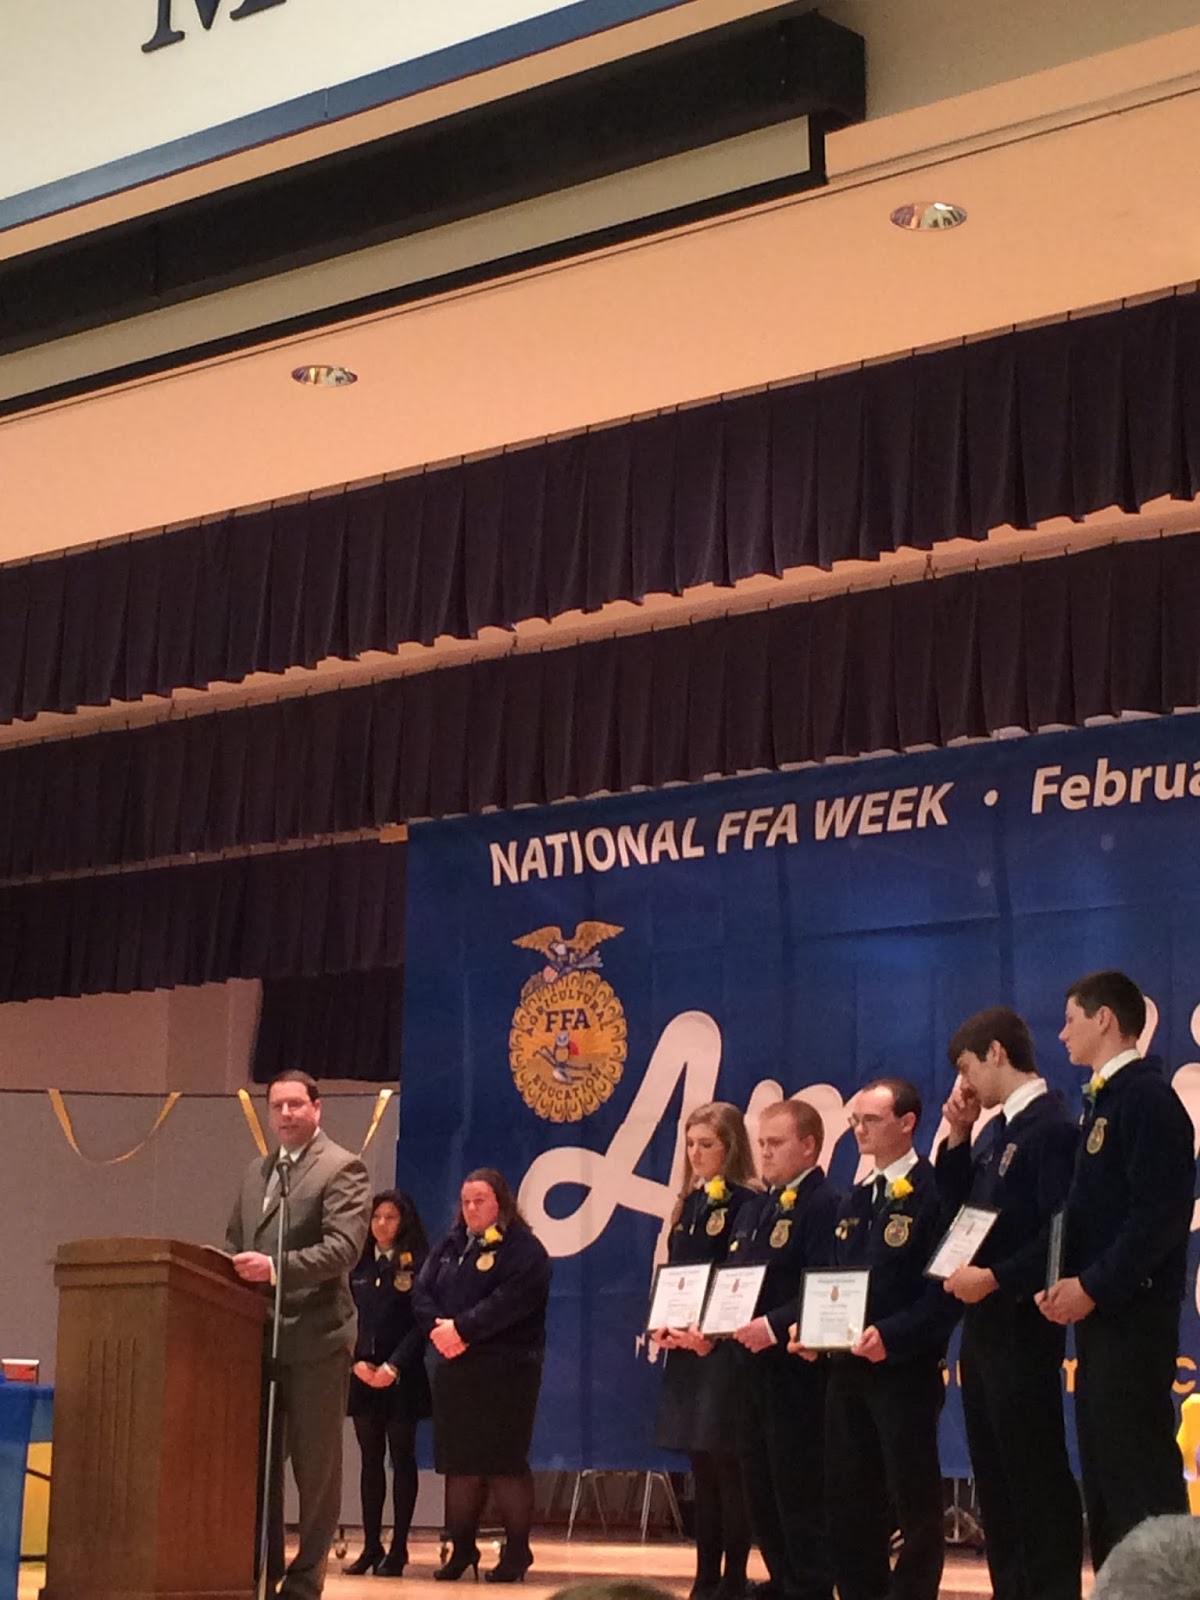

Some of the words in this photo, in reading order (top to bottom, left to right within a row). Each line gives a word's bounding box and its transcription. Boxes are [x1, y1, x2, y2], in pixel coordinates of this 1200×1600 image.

[489, 816, 705, 886] NATIONAL
[717, 803, 798, 854] FFA
[815, 782, 955, 841] WEEK
[545, 1008, 591, 1033] FFA
[532, 1068, 602, 1101] EDUCATION
